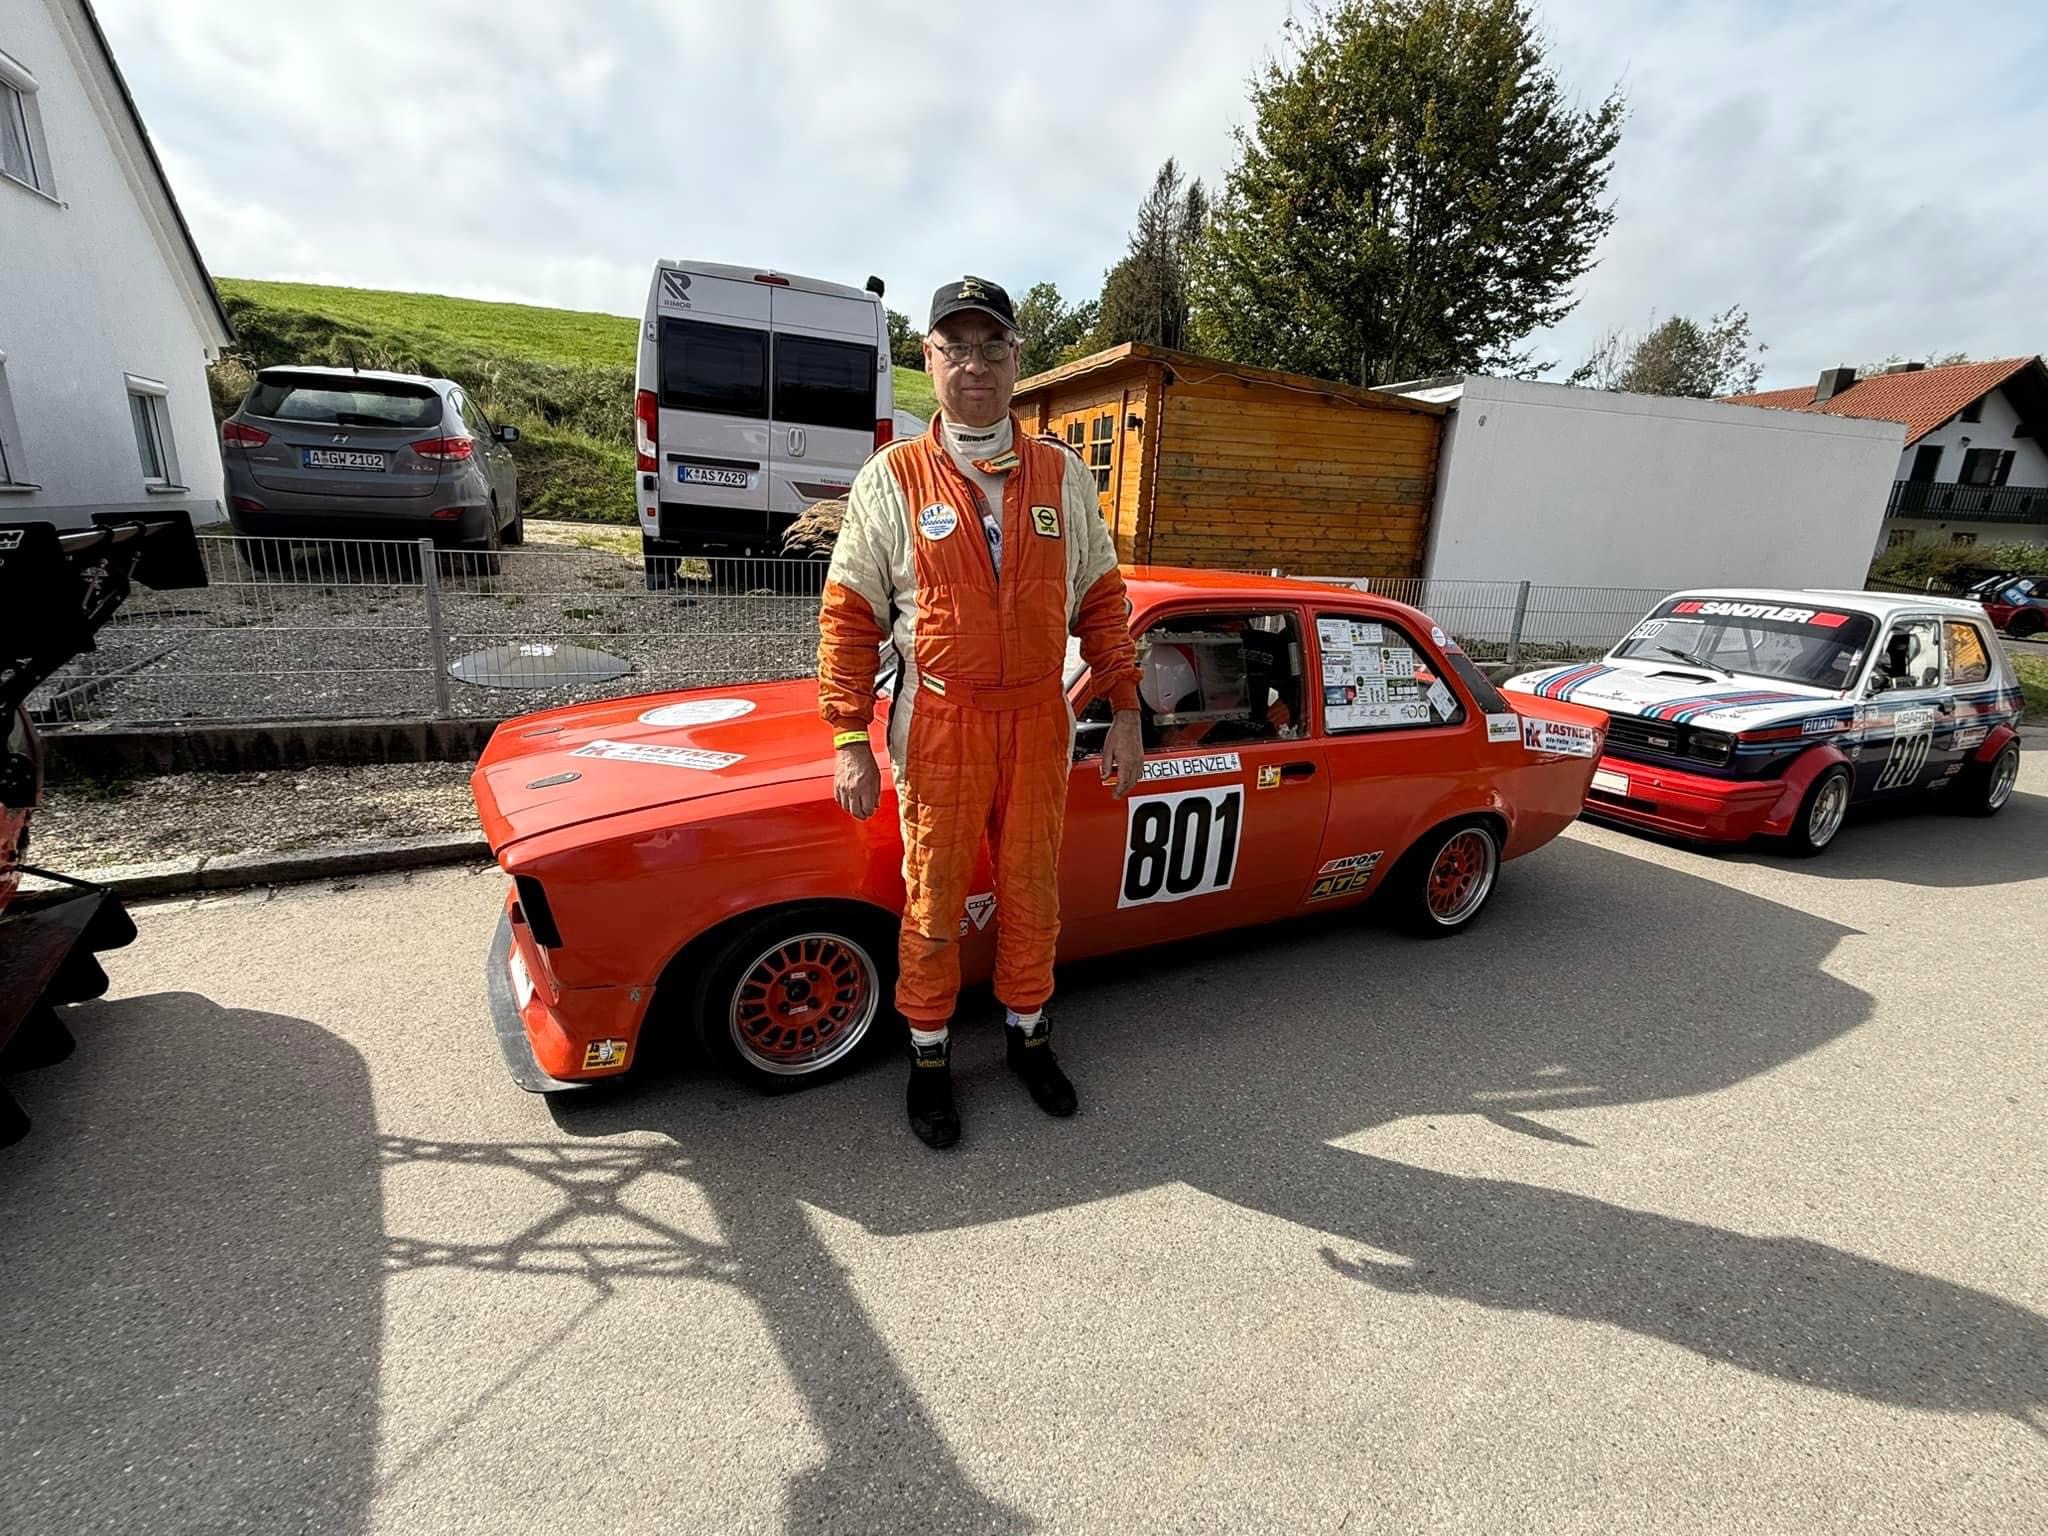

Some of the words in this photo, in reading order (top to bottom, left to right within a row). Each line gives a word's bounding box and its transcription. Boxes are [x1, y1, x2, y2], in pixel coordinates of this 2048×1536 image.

[663, 299, 692, 309] RIMOR
[312, 452, 321, 464] A
[329, 452, 347, 465] GW
[350, 453, 383, 467] 2102
[685, 467, 694, 480] K
[700, 469, 717, 482] AS
[717, 470, 745, 485] 7629
[1697, 602, 1815, 624] SANDTLER
[1804, 717, 1836, 731] FIAT
[1896, 711, 1933, 724] ABARTH
[1545, 722, 1592, 740] KASTNER
[631, 745, 738, 762] KASTNER
[1878, 733, 1930, 788] 810
[1138, 762, 1180, 779] RGEN
[1183, 756, 1231, 774] BENZEL
[1123, 791, 1241, 902] 801
[1335, 852, 1382, 868] AVON
[1312, 872, 1370, 895] ATS
